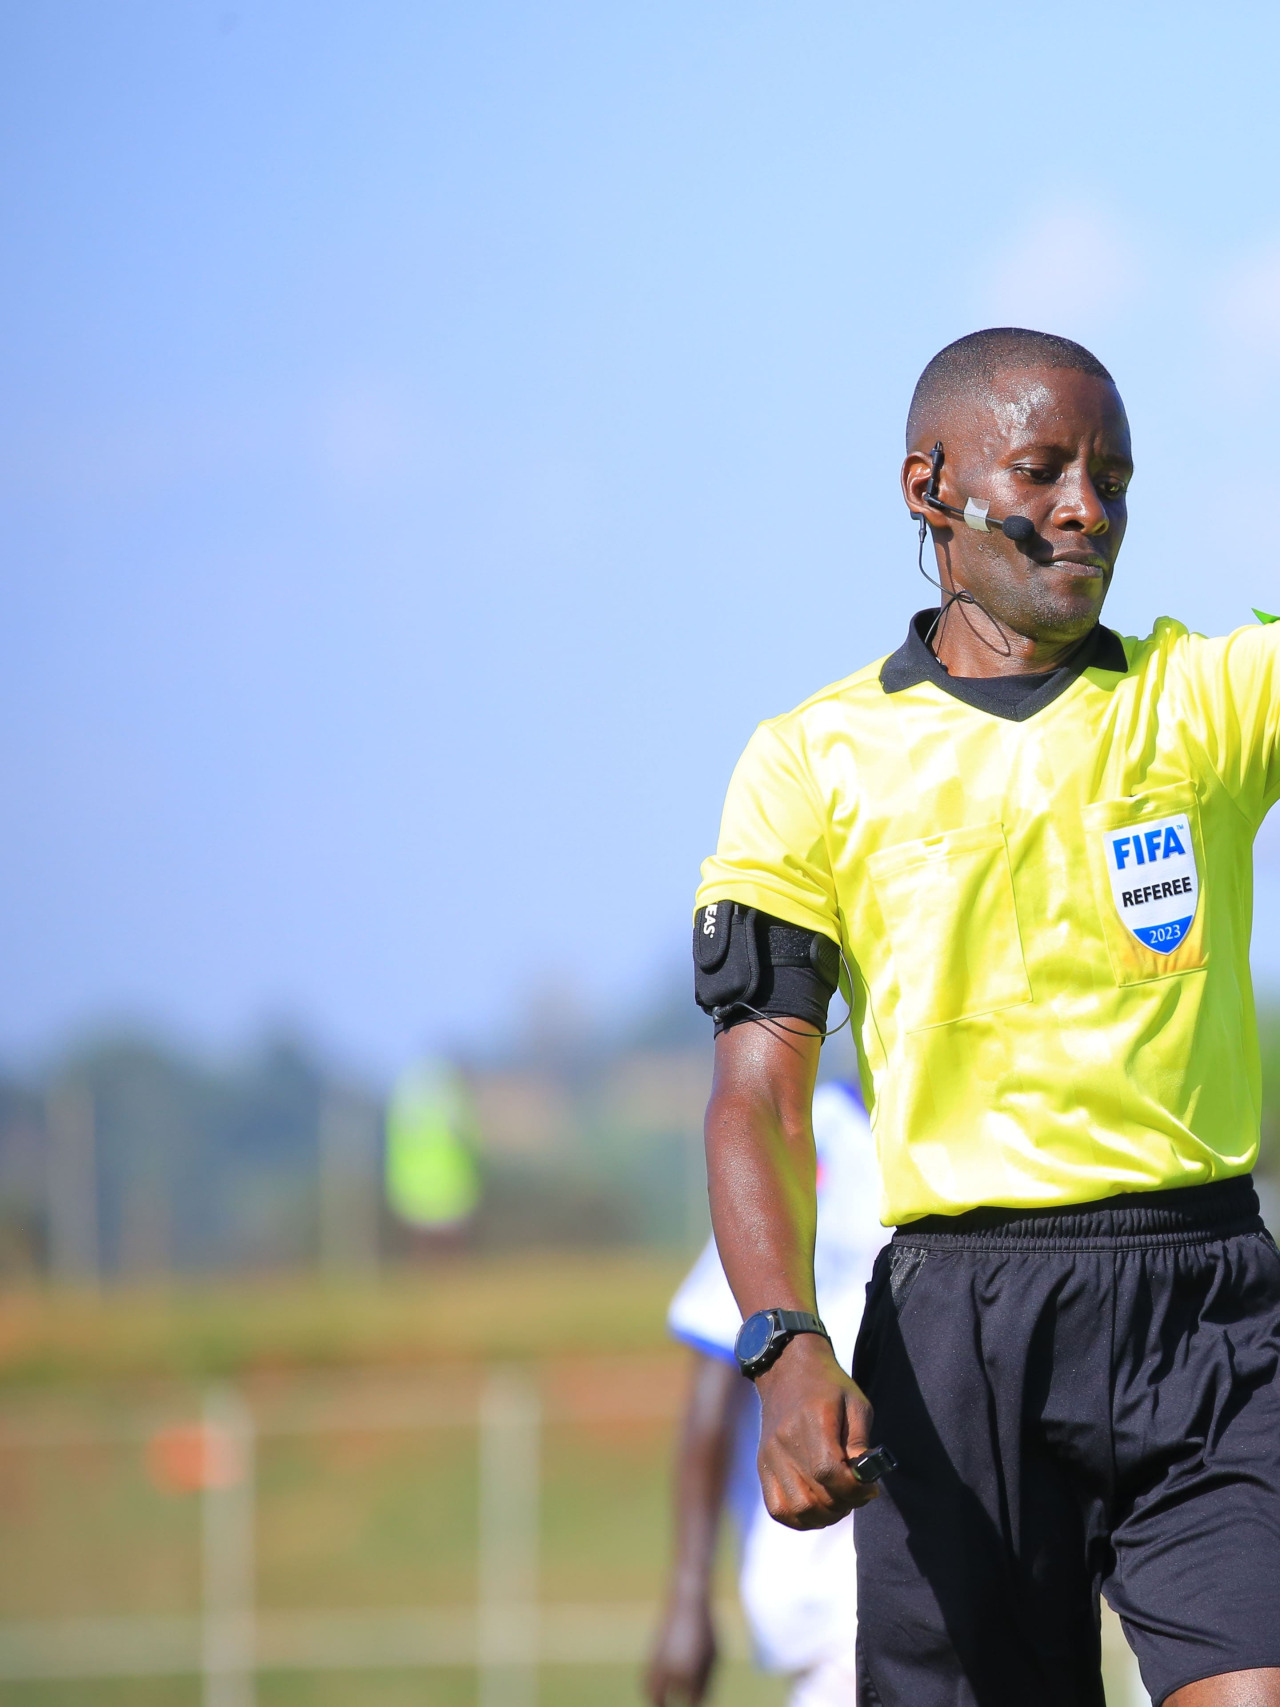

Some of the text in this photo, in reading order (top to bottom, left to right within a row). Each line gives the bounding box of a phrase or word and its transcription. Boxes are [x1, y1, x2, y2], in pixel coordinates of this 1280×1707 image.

[1112, 826, 1186, 870] FIFA
[1121, 876, 1193, 908] REFEREE
[1149, 924, 1181, 944] 2023
